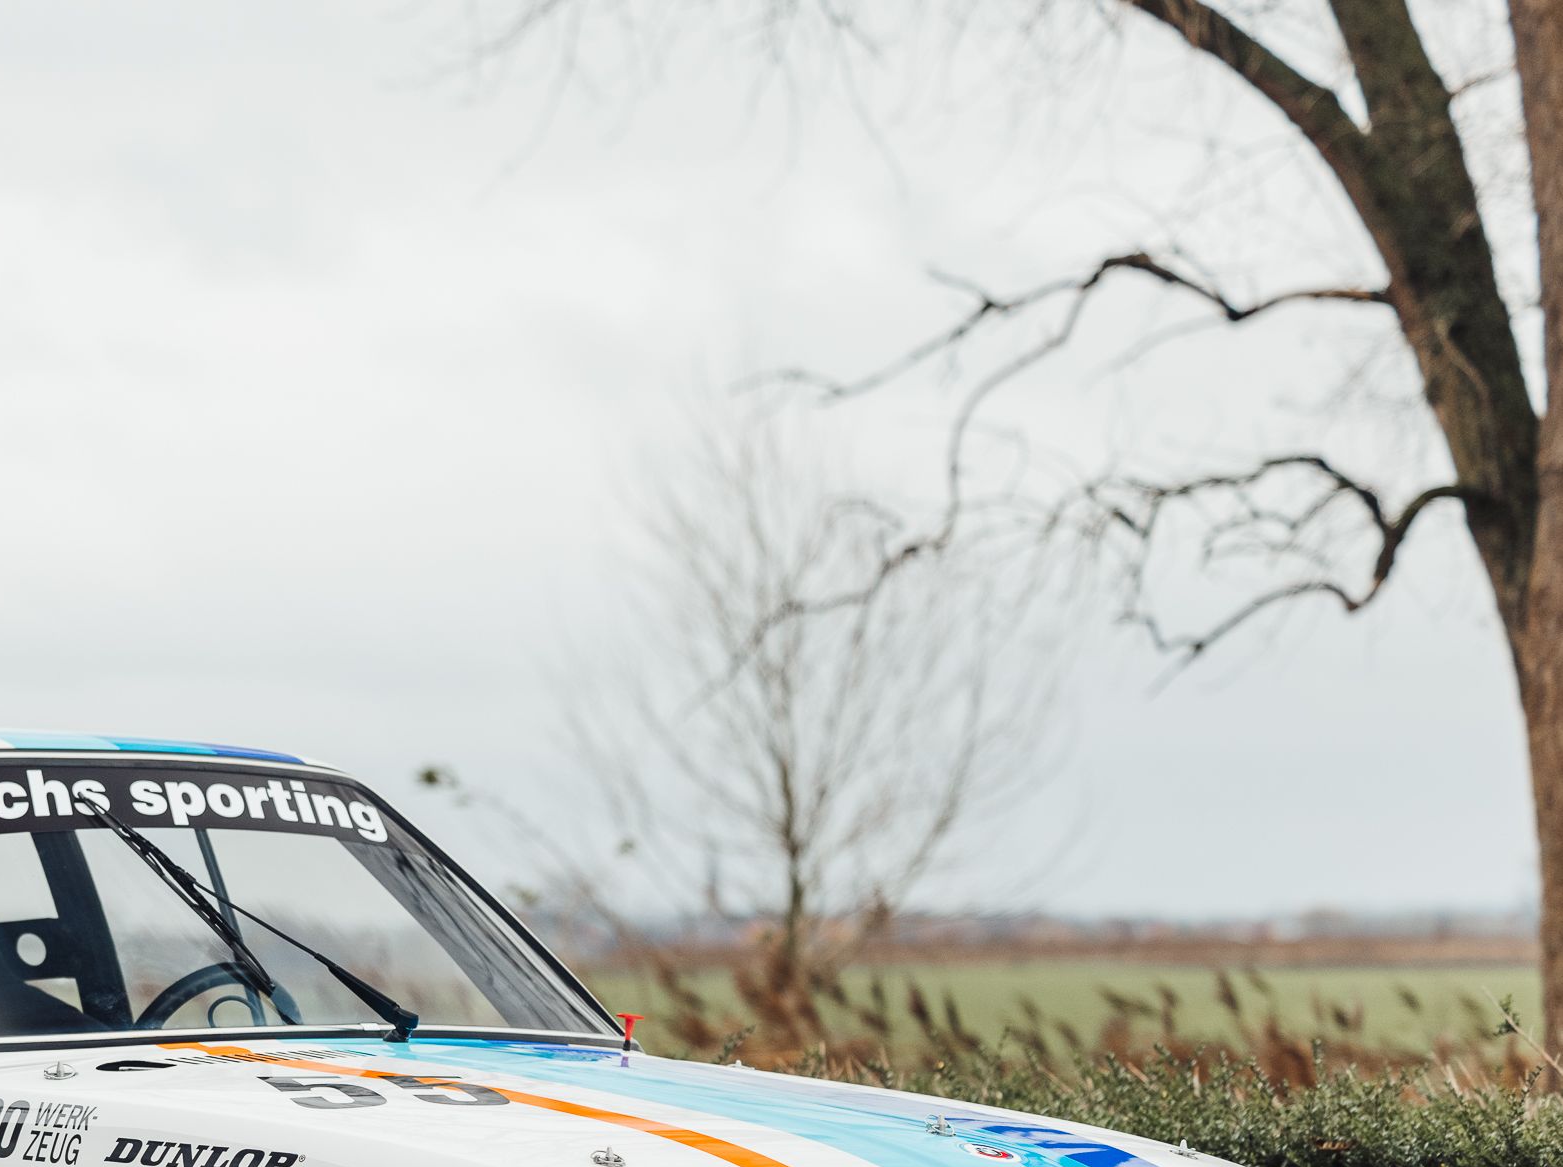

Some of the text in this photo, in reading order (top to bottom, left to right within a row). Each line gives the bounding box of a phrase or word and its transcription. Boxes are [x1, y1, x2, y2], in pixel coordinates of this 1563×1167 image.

[129, 779, 389, 843] sporting
[256, 1075, 511, 1110] 55
[22, 1130, 83, 1166] ZEUG
